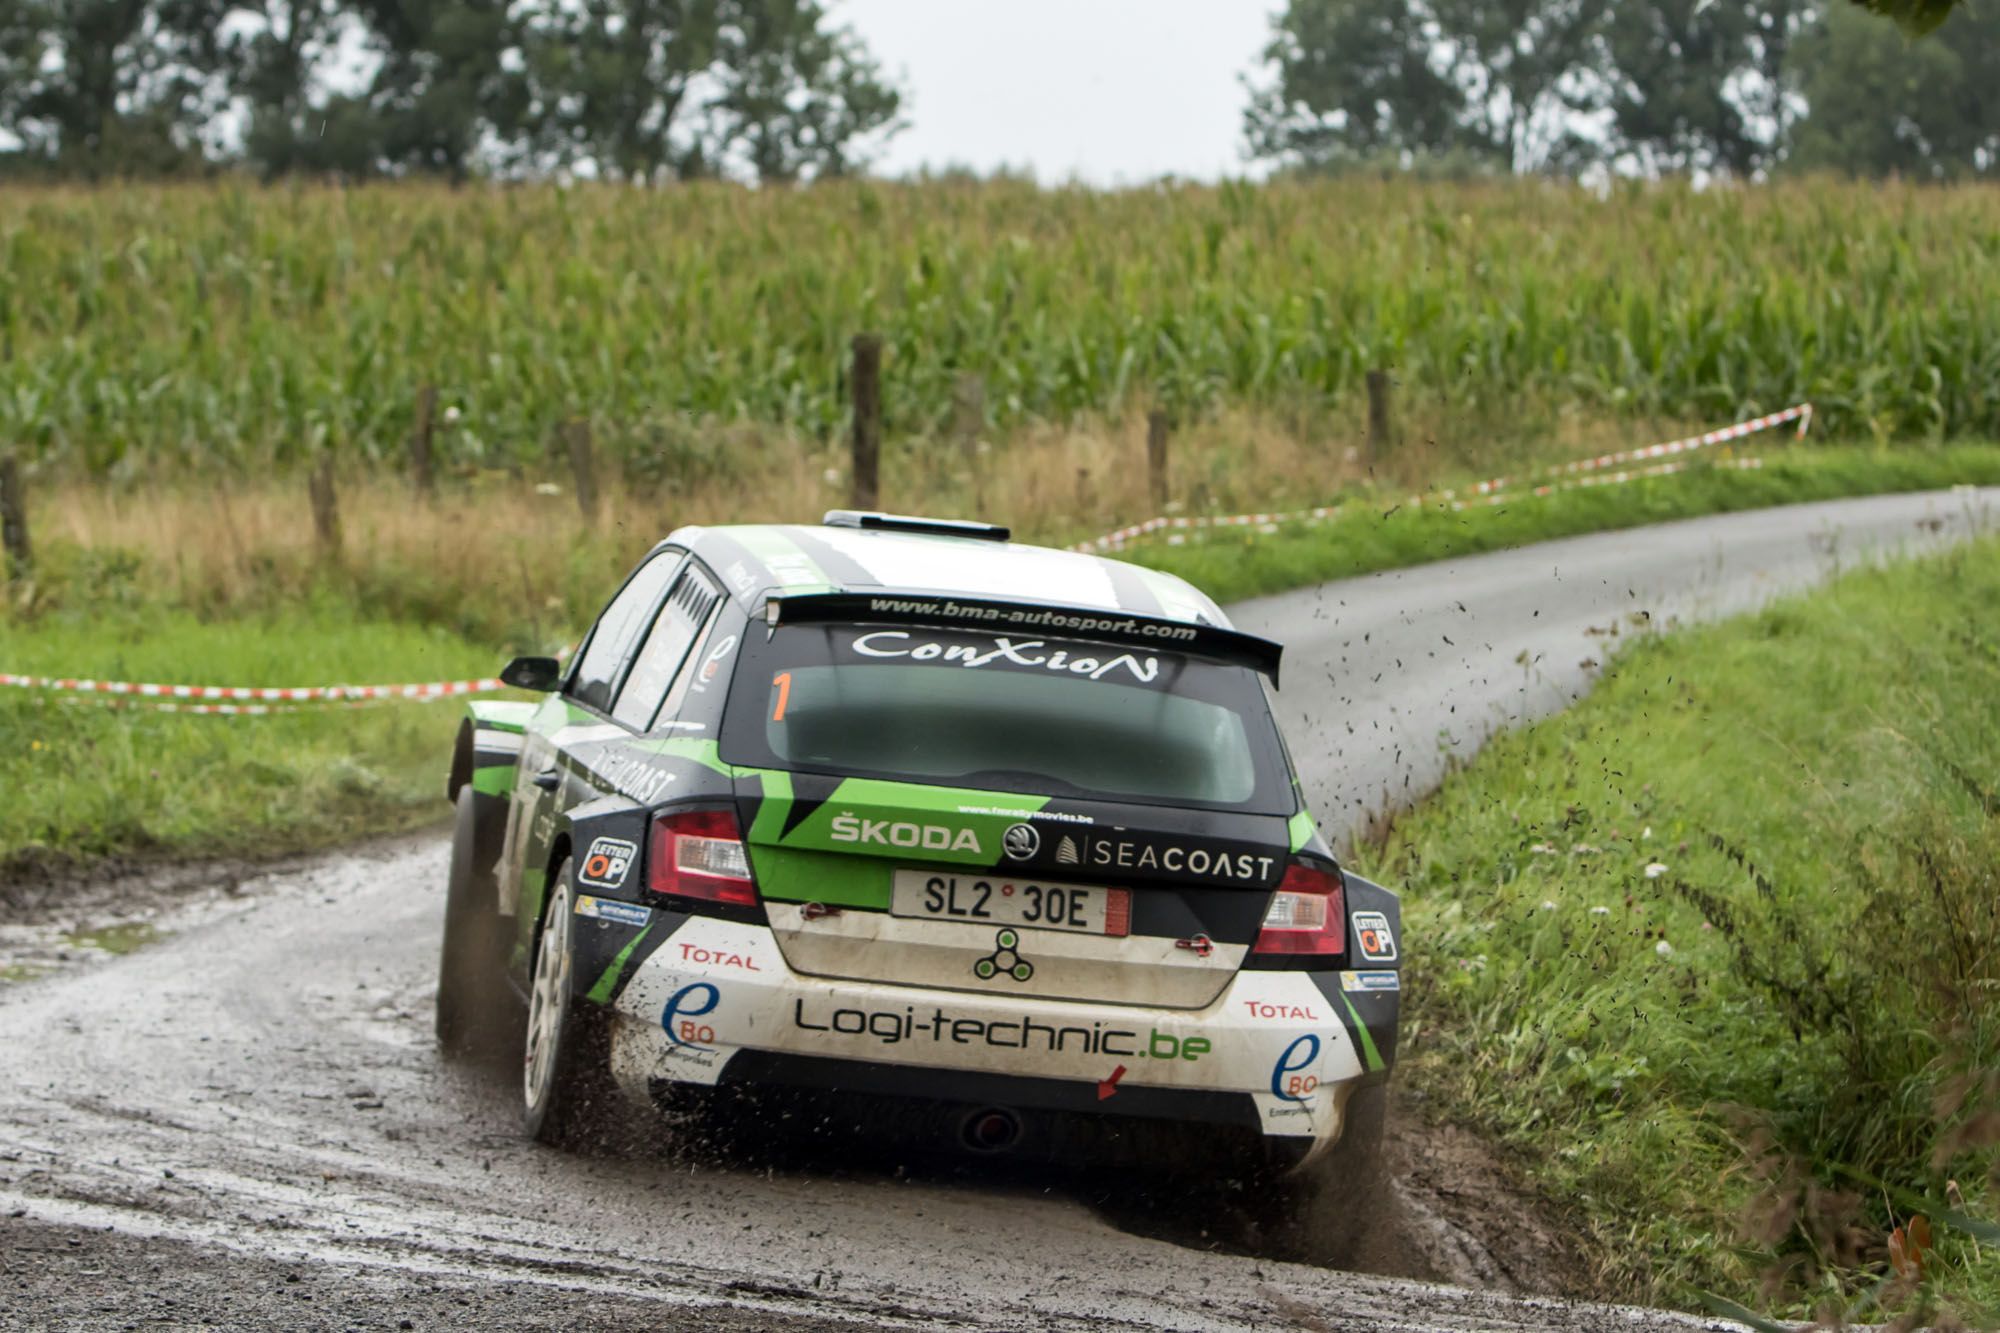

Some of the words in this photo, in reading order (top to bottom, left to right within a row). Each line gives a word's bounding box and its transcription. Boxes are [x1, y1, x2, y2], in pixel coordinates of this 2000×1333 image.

[870, 598, 1198, 641] www.bma-autosport.com
[772, 672, 792, 721] 1
[830, 812, 982, 854] ŠKODA
[1094, 840, 1275, 881] SEACOAST
[924, 876, 991, 918] SL2
[1021, 885, 1089, 927] 30E
[678, 943, 761, 972] TOTAL
[794, 998, 1212, 1061] Logi-technic.be
[1244, 1001, 1319, 1020] TOTAL
